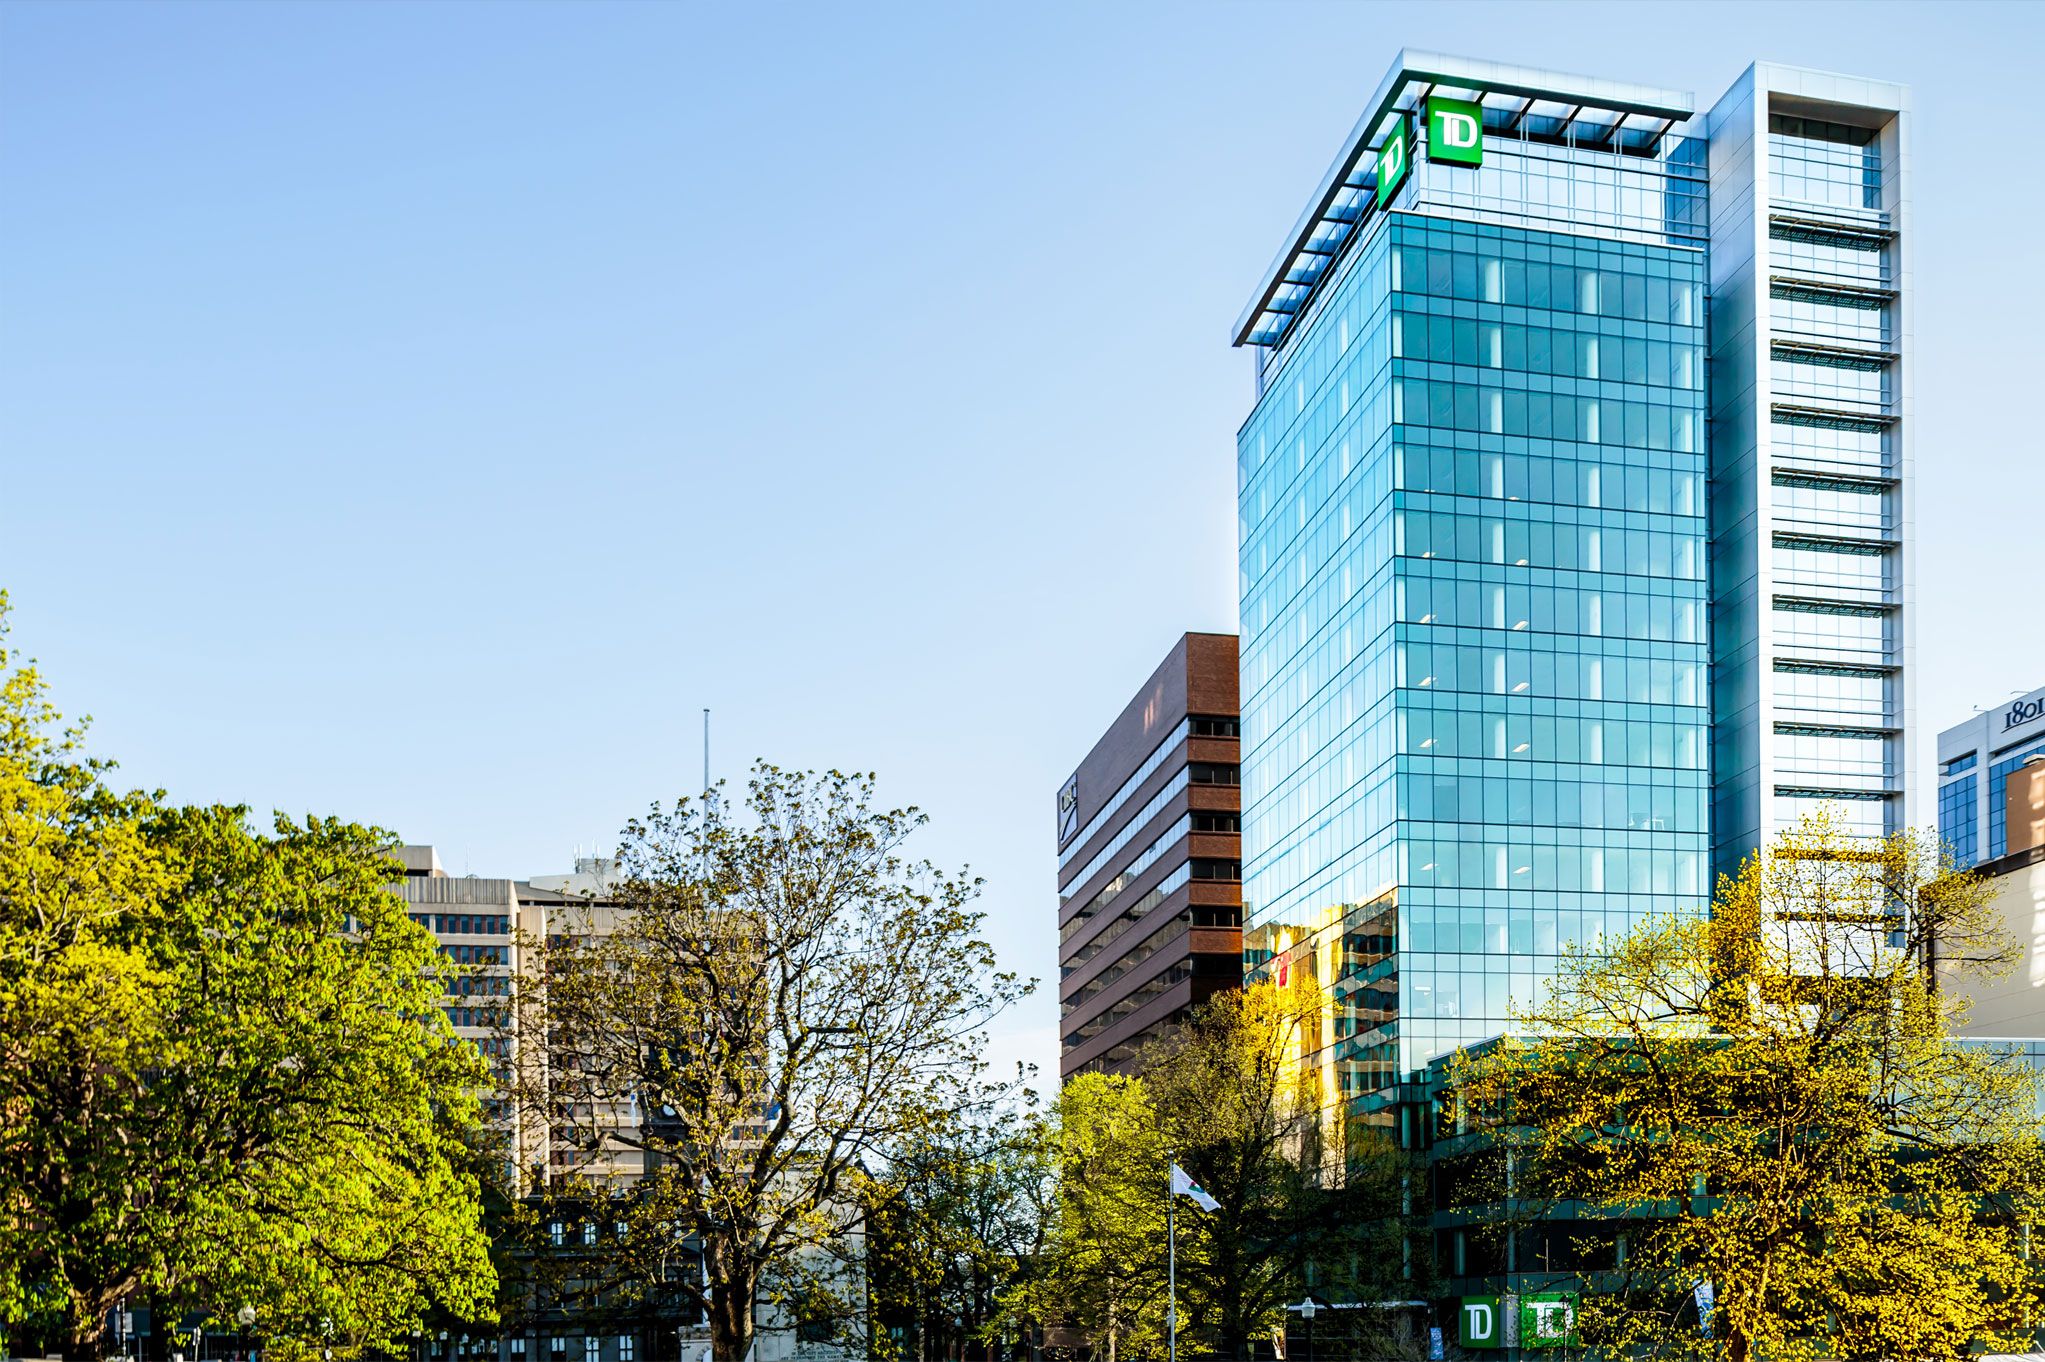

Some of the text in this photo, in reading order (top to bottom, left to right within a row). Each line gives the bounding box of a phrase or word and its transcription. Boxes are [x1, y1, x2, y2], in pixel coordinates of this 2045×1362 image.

[1434, 110, 1478, 148] TD
[1380, 135, 1403, 187] TD
[2004, 697, 2045, 729] 1801
[1464, 1303, 1493, 1340] TD
[1526, 1301, 1574, 1339] TD
